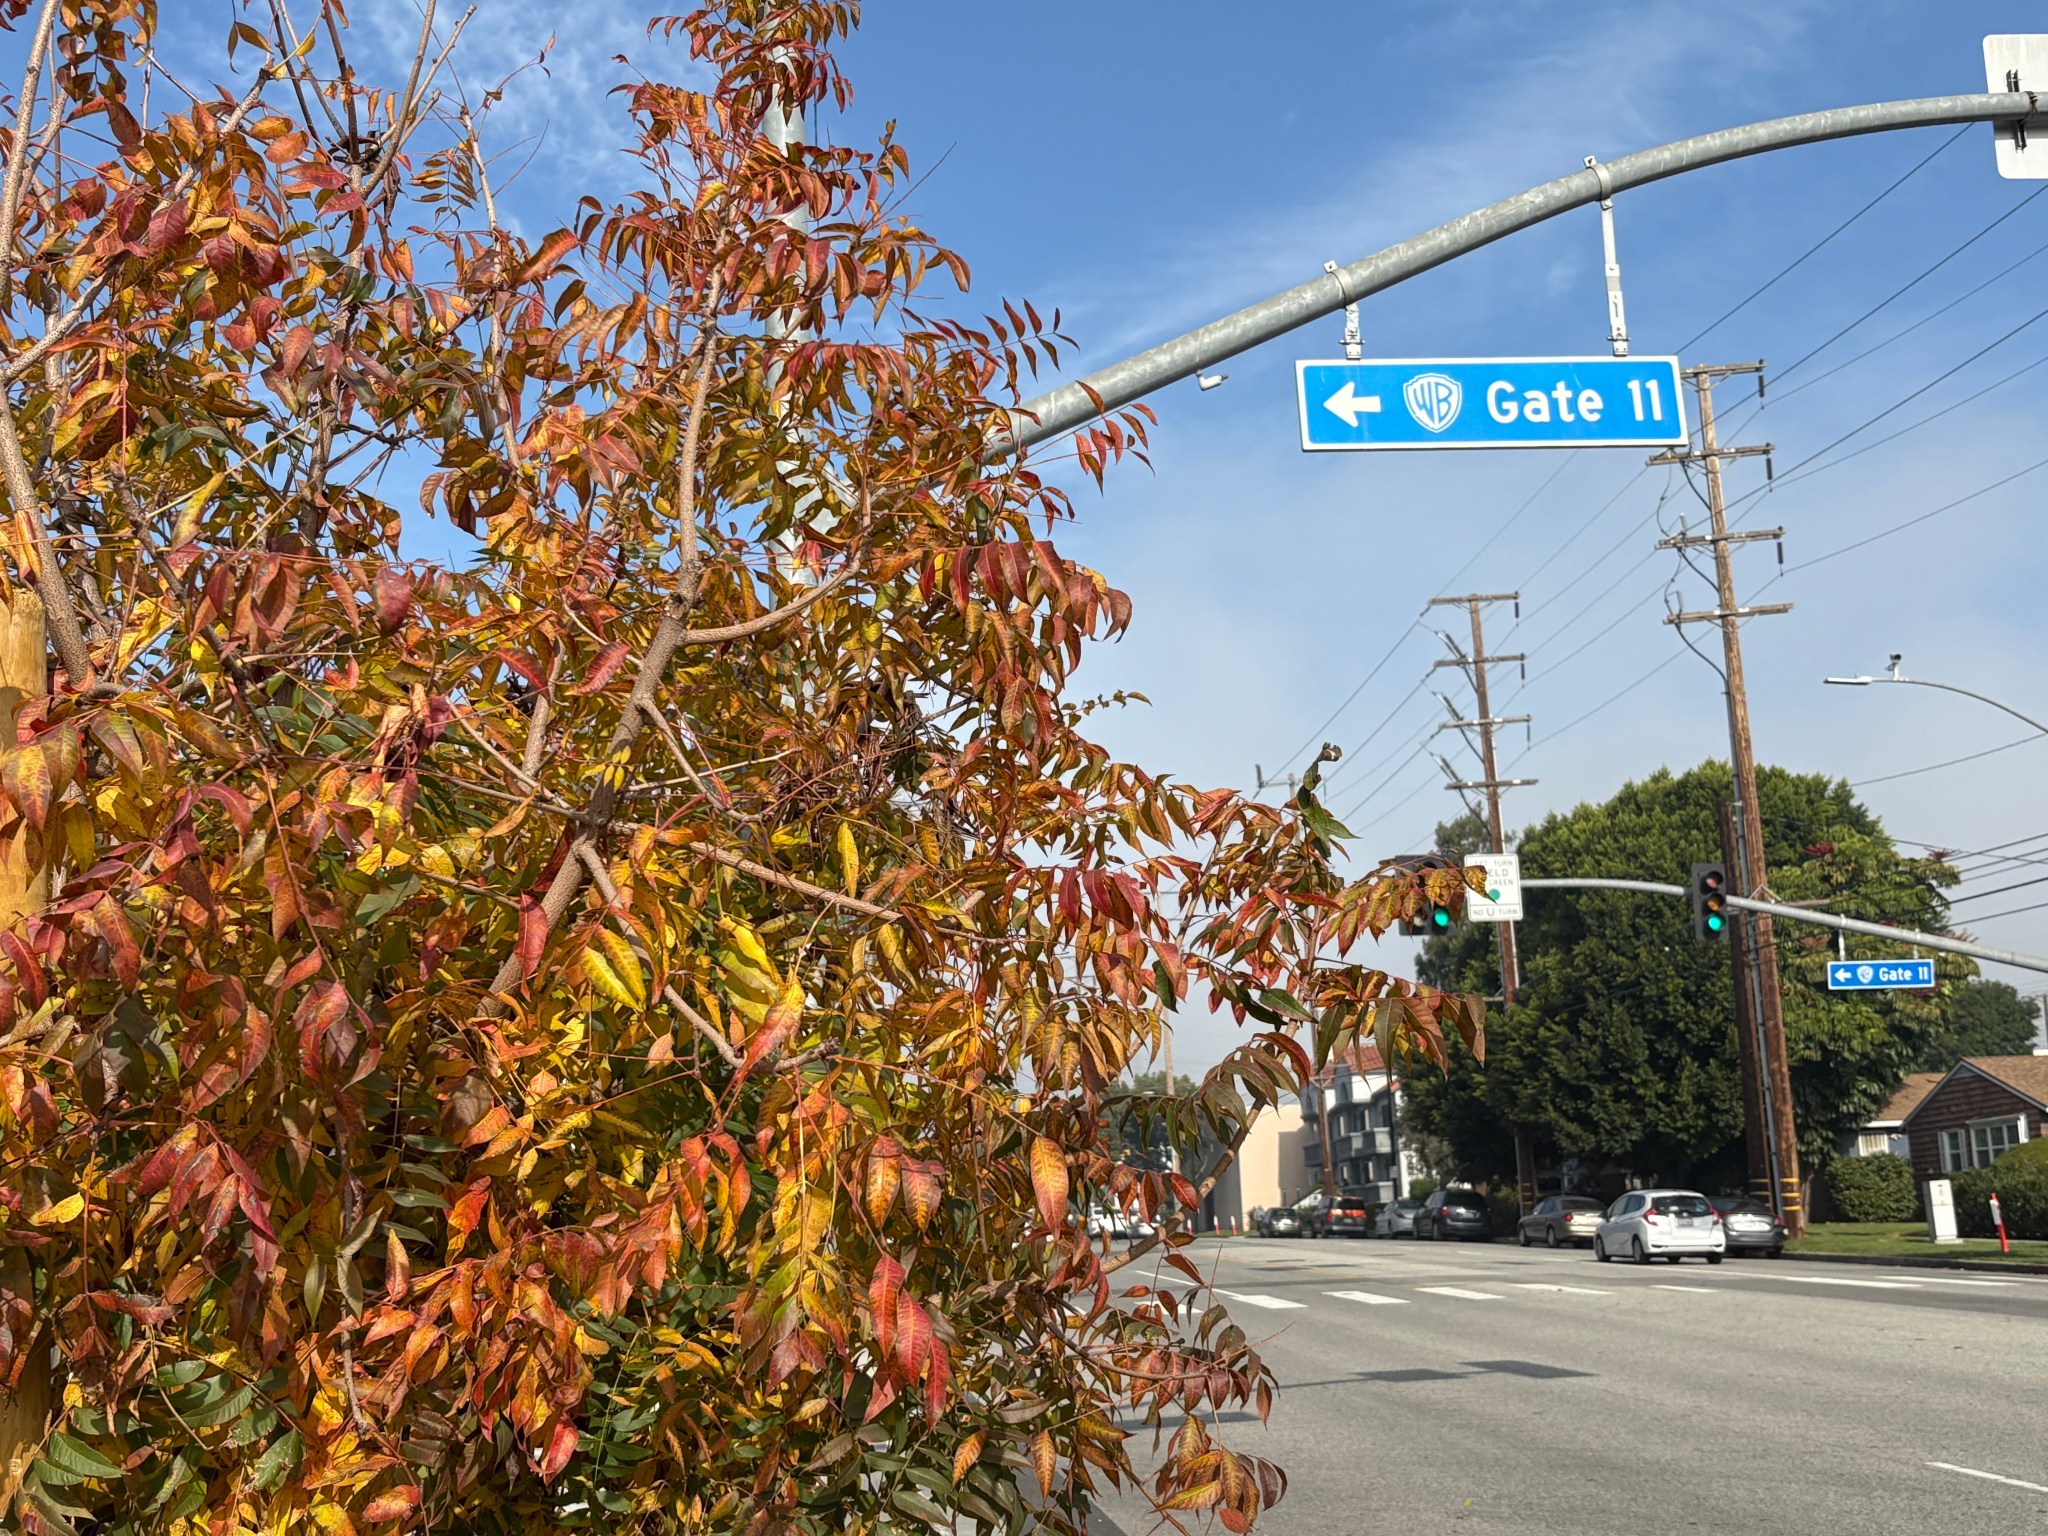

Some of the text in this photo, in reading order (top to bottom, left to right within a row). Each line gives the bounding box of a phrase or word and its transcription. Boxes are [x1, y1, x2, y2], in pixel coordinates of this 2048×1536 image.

[1406, 376, 1662, 430] WB Gate 11
[1485, 868, 1509, 877] ELD
[1486, 907, 1495, 917] U
[1879, 967, 1913, 982] Gate
[1918, 966, 1929, 980] 11
